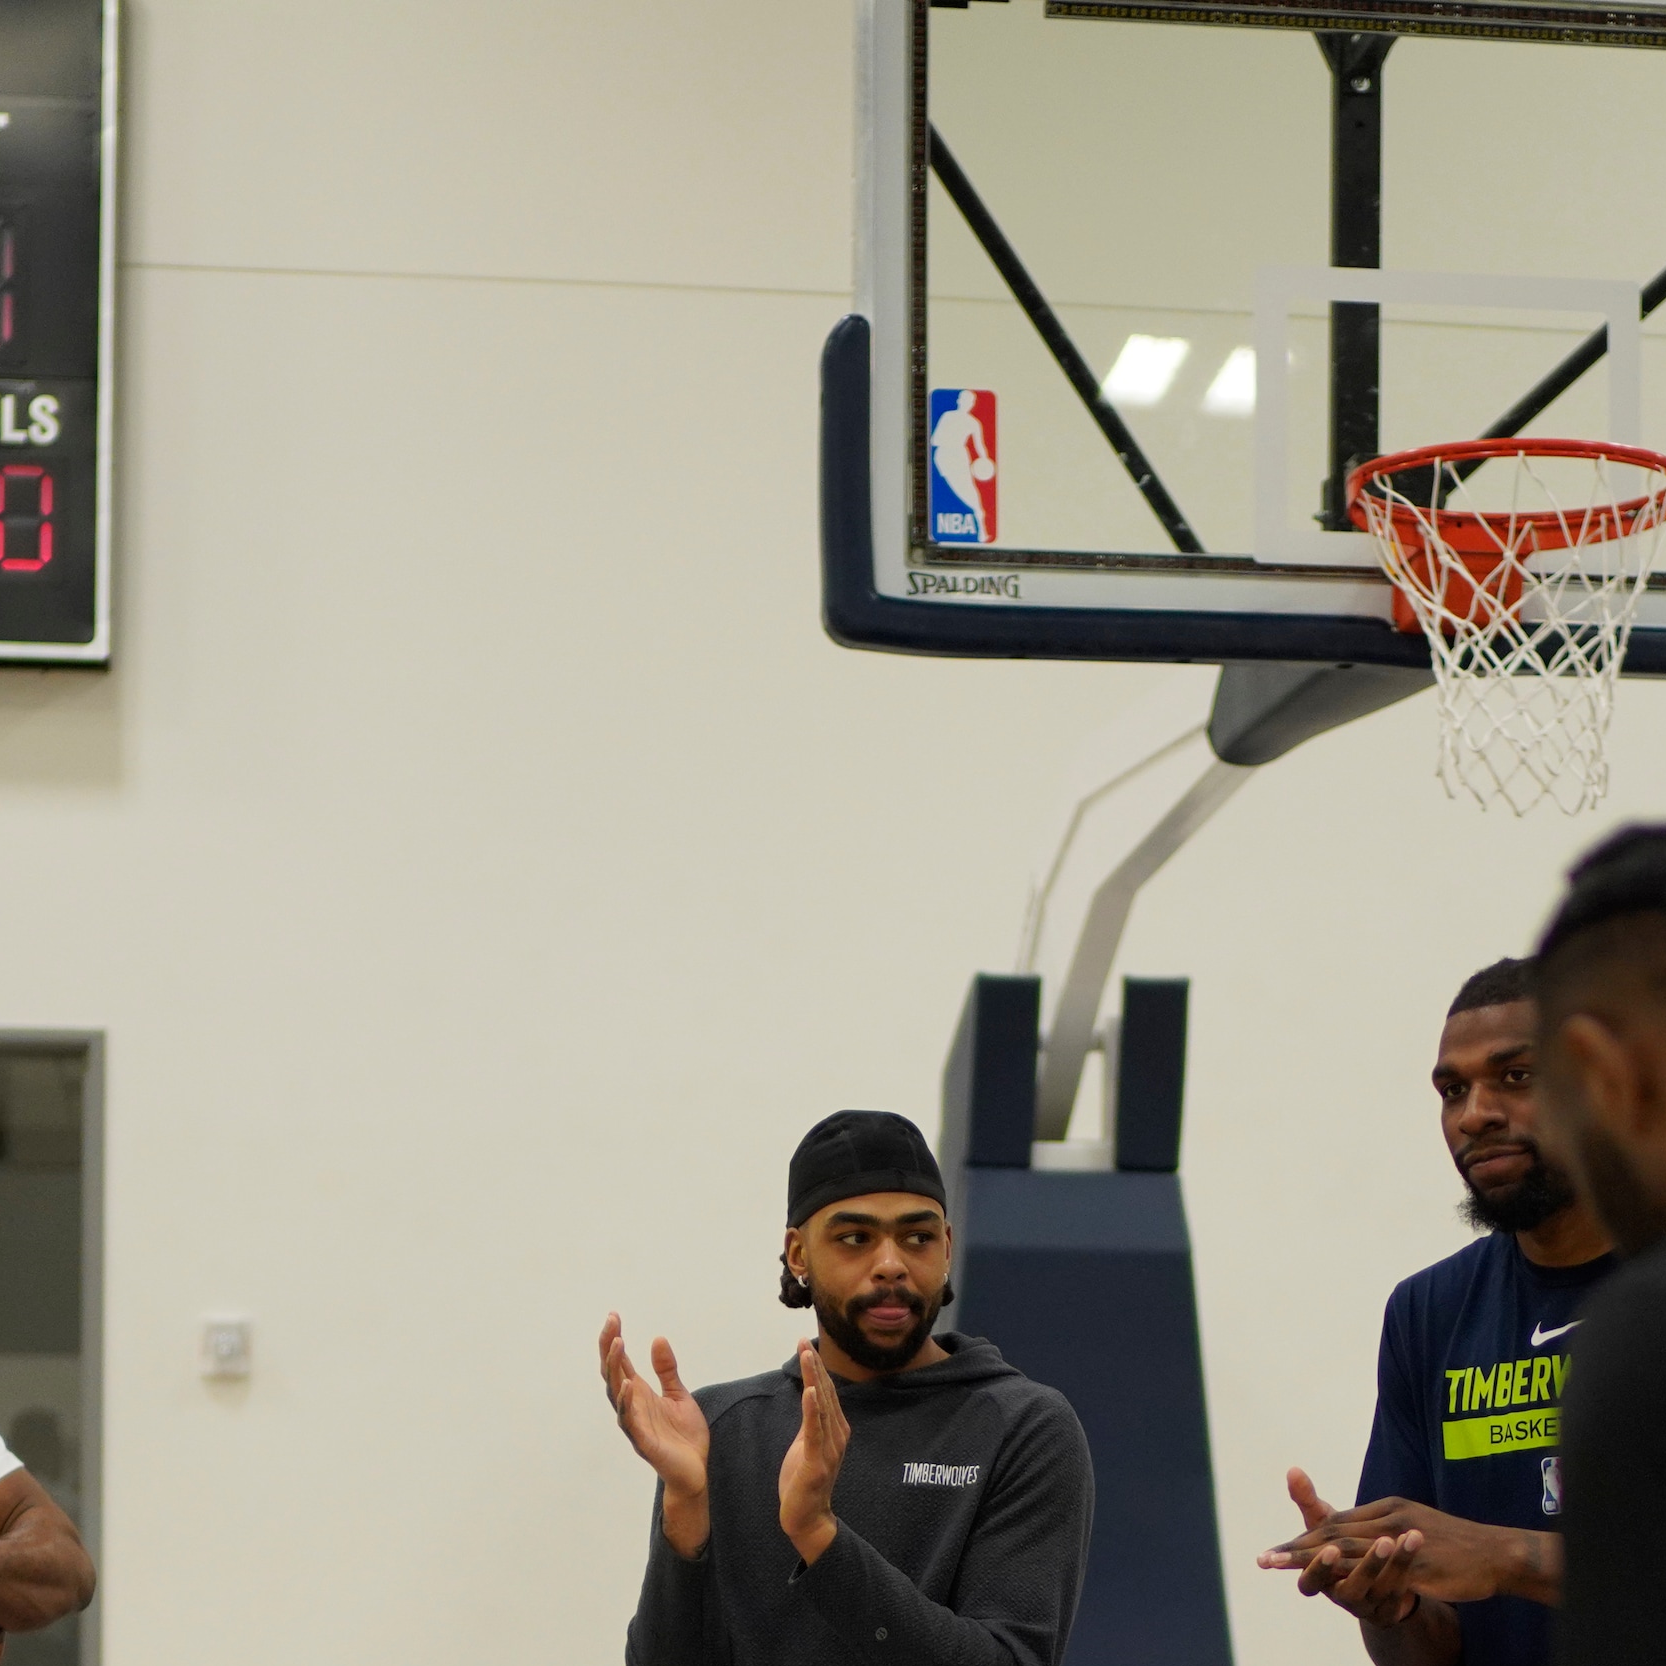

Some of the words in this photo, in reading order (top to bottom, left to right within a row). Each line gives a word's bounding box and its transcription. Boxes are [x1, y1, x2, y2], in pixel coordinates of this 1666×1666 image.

[936, 512, 977, 535] NBA
[906, 570, 1022, 600] SPALDING
[1490, 1416, 1561, 1444] BASKE
[902, 1462, 980, 1488] TIMBERWOLVES
